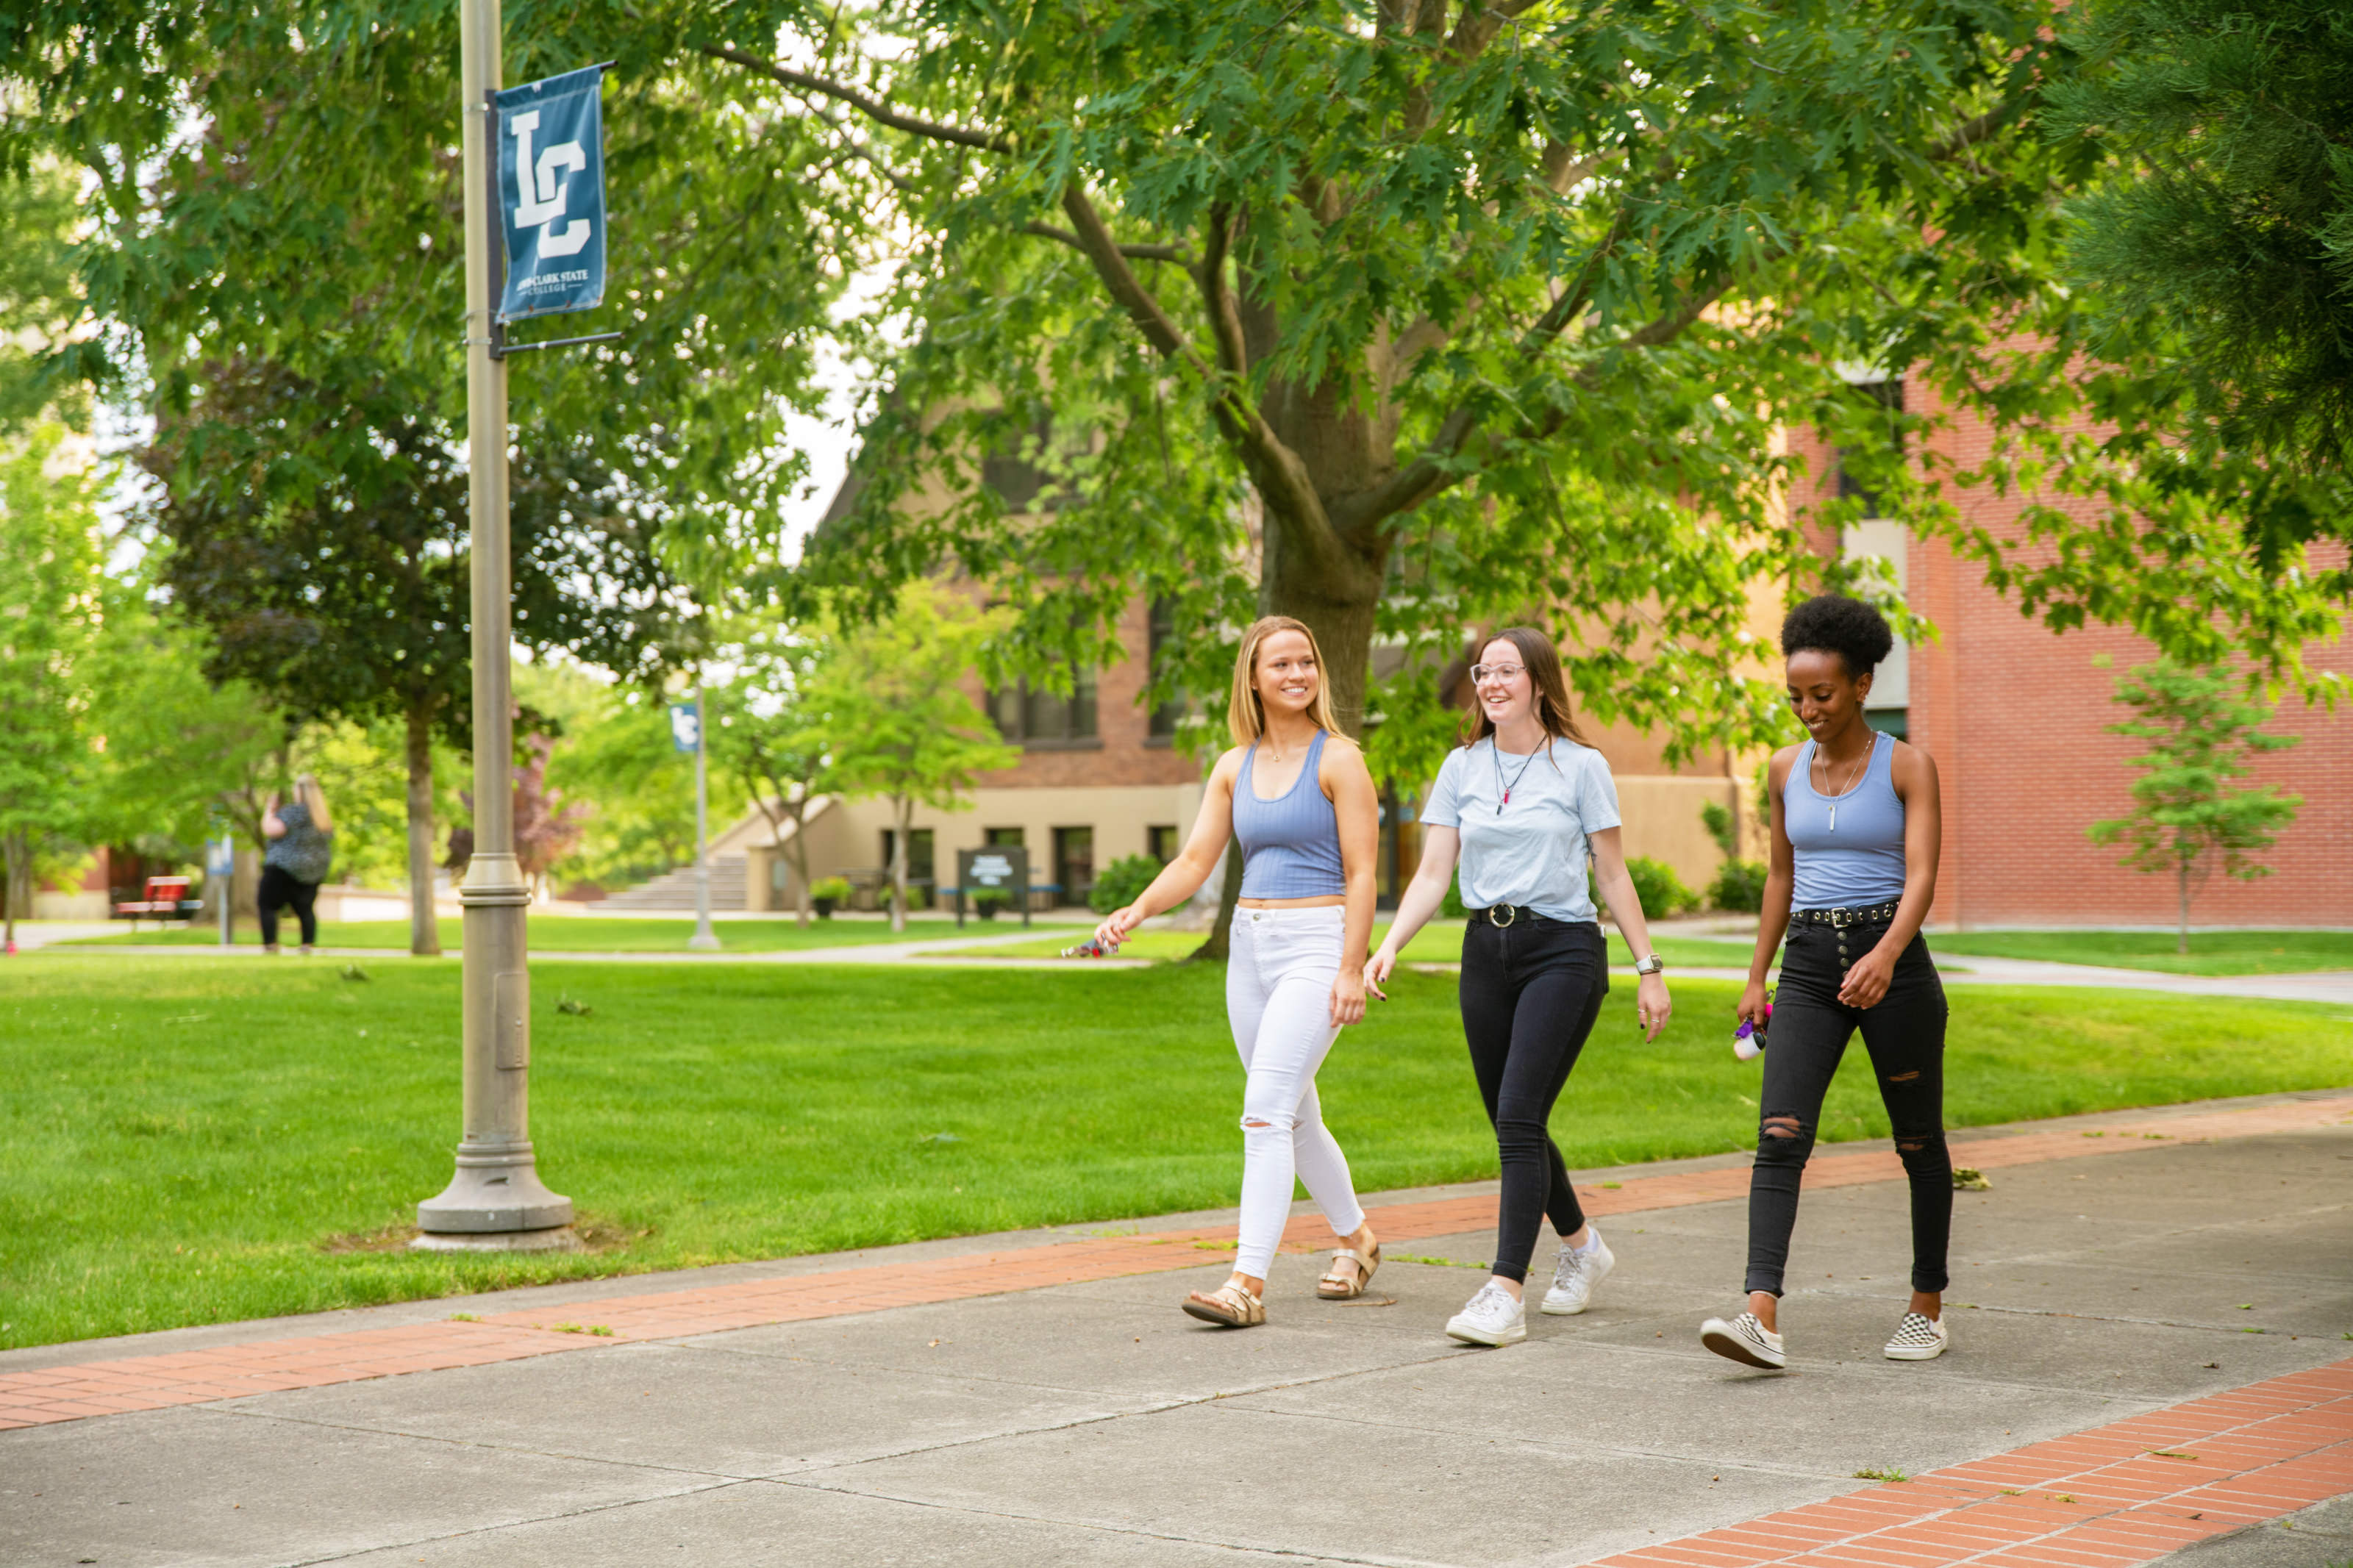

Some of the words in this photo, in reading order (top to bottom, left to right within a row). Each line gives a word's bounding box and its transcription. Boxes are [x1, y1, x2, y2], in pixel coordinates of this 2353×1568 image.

[511, 110, 590, 259] LC
[560, 270, 588, 282] STATE
[529, 283, 567, 296] COLLEGE
